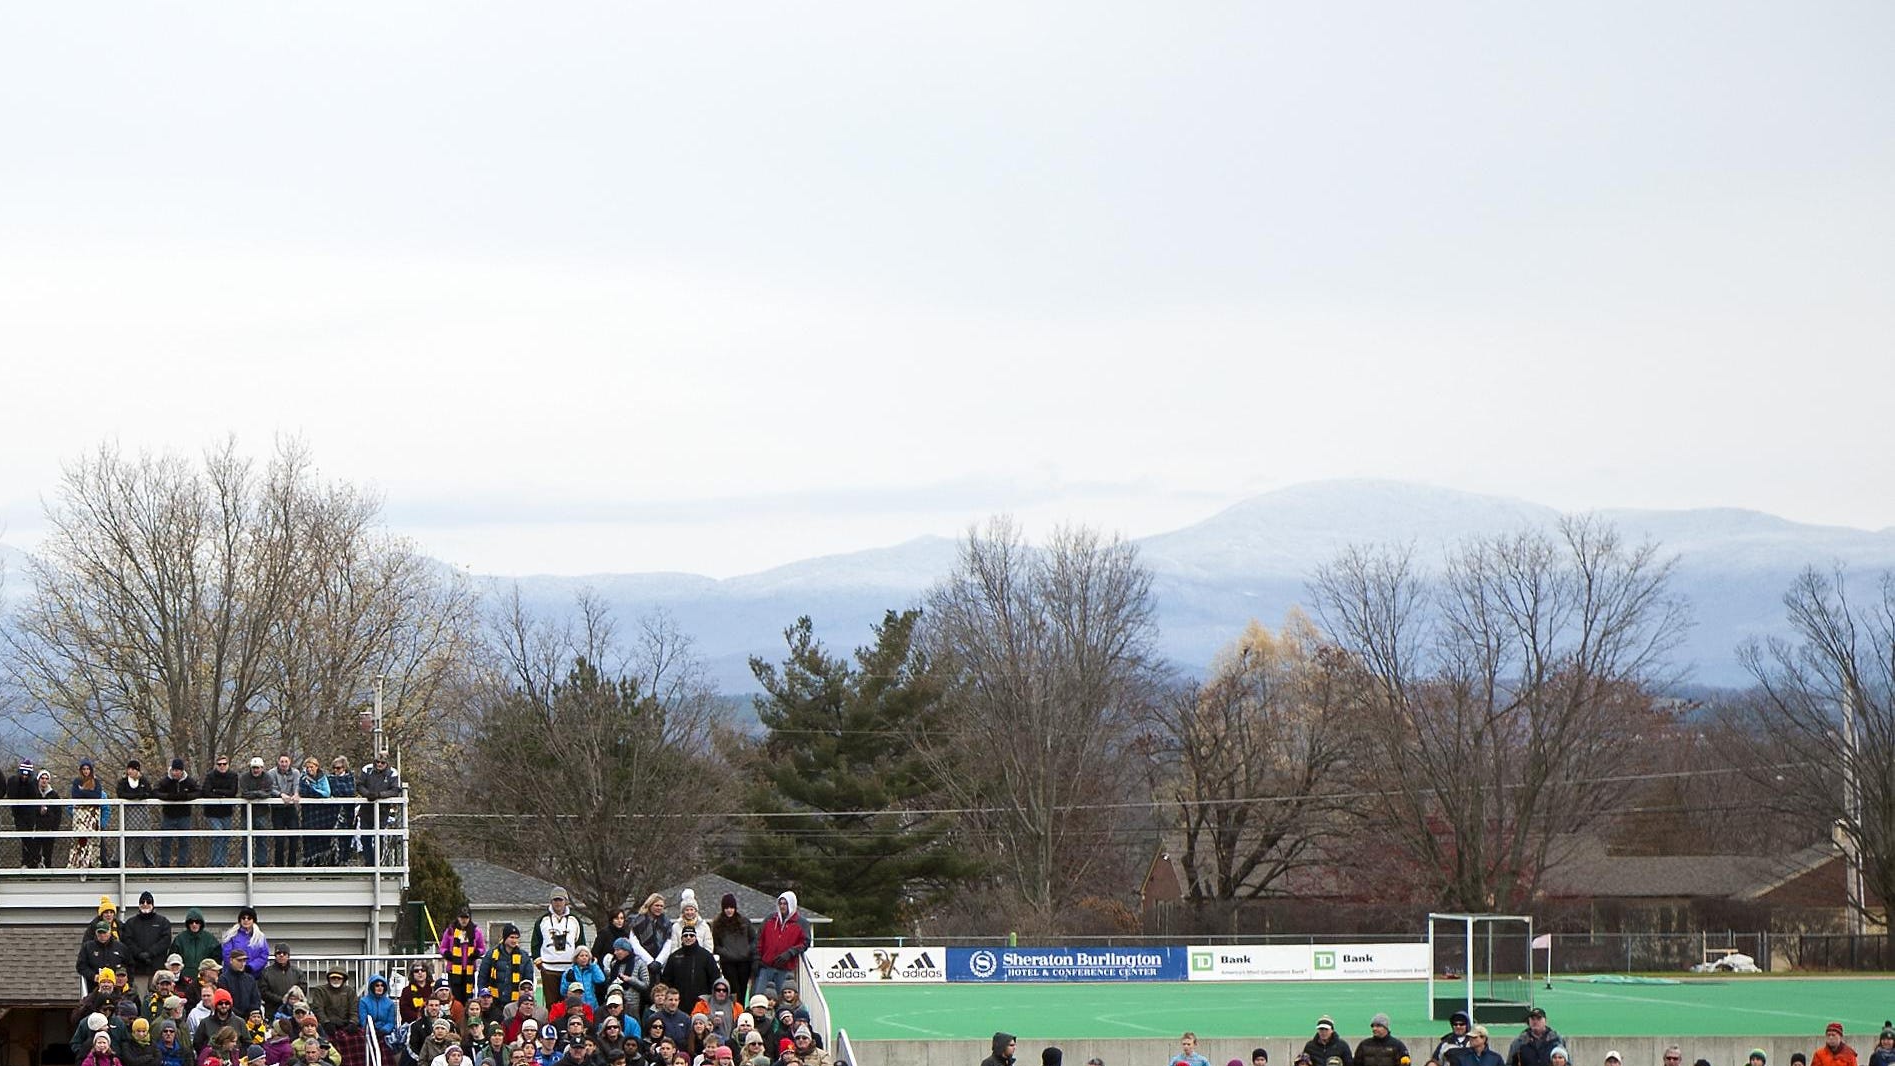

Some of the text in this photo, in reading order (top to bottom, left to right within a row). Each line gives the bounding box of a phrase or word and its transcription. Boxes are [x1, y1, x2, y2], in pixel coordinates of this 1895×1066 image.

[1003, 953, 1162, 968] Sheraton Burlington
[1193, 954, 1251, 969] TD Bank
[1315, 953, 1373, 968] TD Bank
[827, 968, 866, 979] adidas
[902, 967, 942, 978] adidas
[1008, 967, 1157, 976] HOTEL & CONFERENCE CENTER
